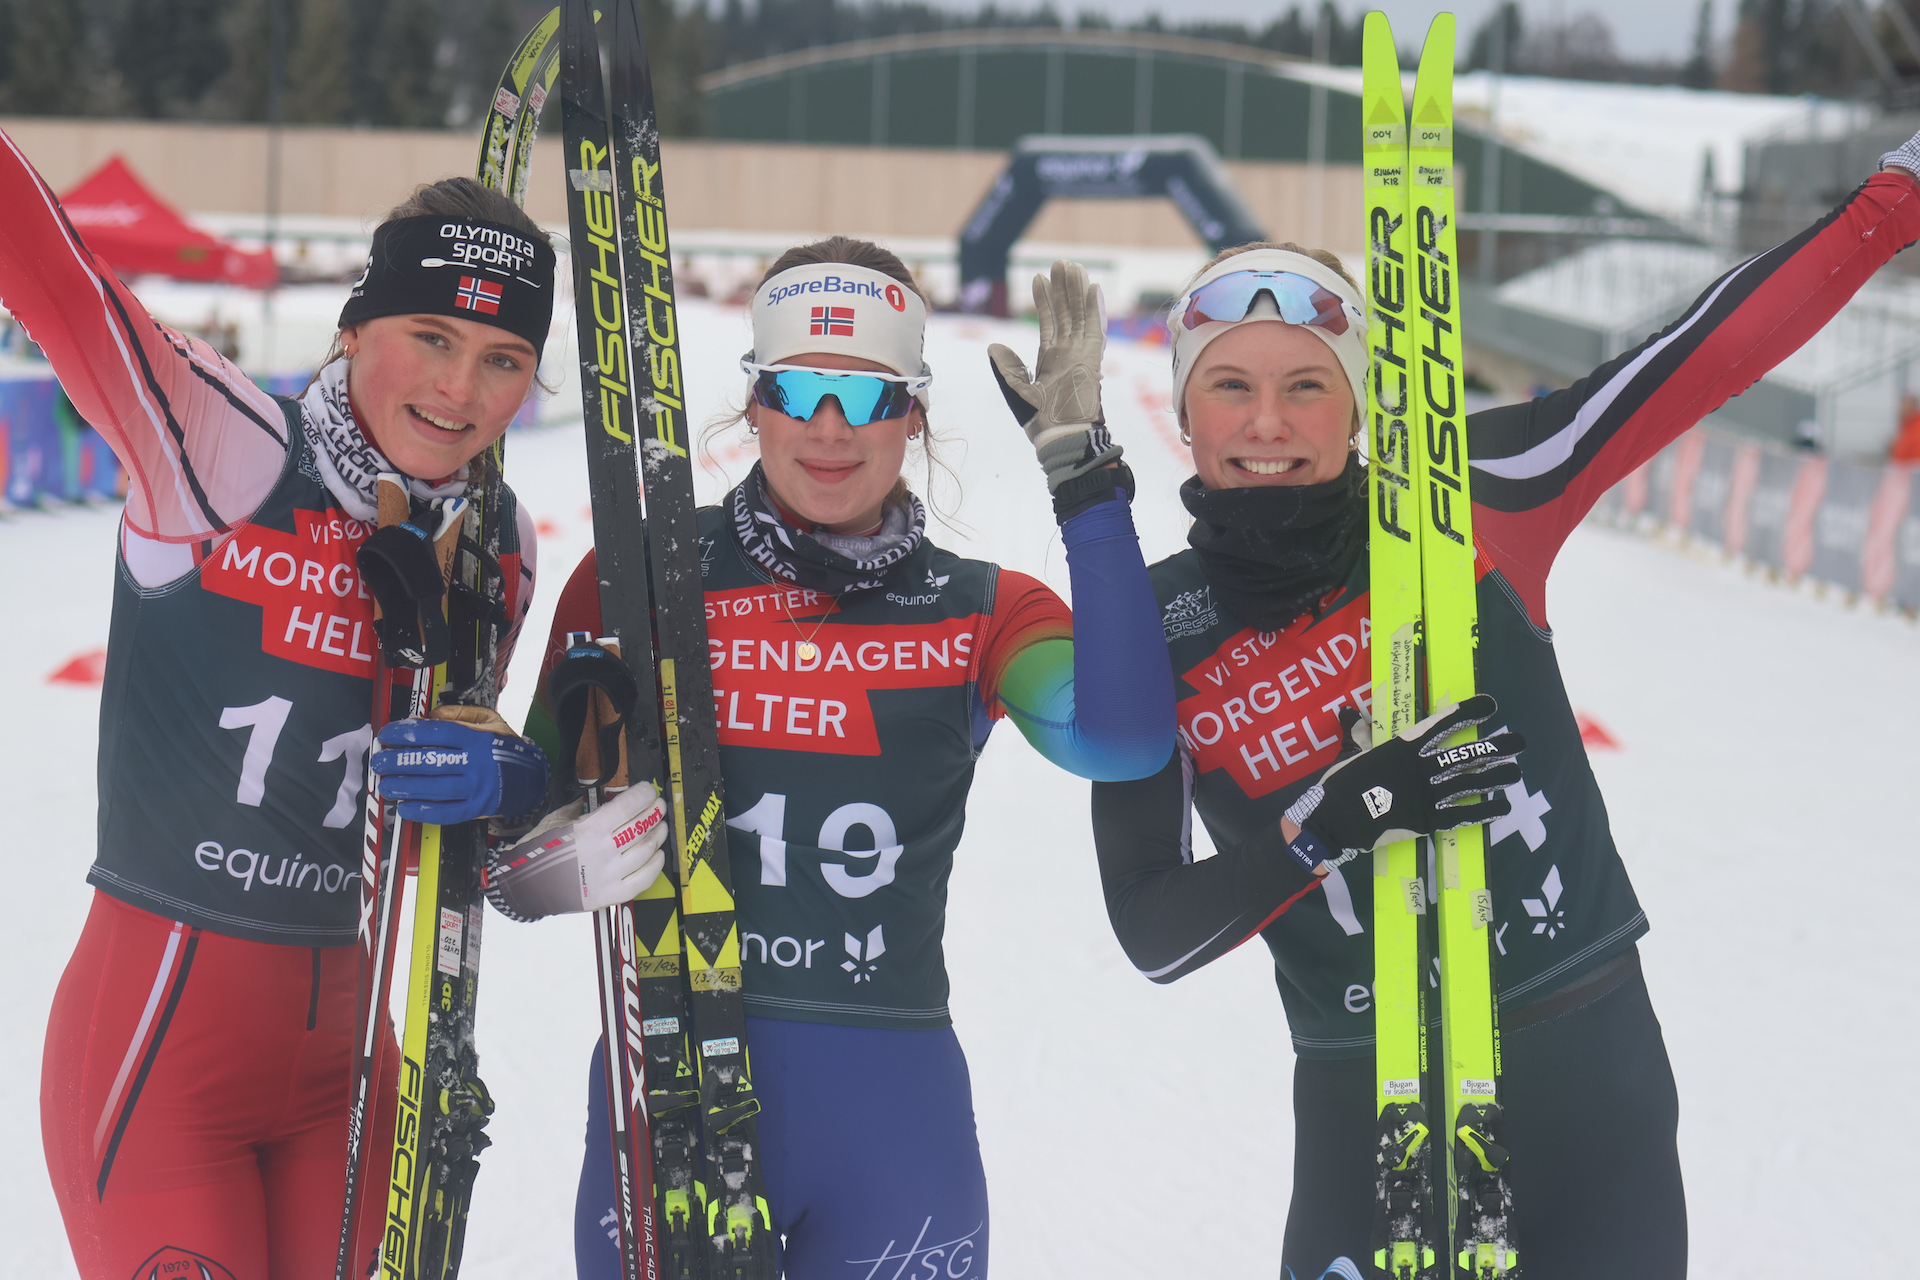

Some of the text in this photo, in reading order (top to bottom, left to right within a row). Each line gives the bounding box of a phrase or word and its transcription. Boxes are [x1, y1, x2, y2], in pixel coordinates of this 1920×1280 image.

[1372, 130, 1392, 139] 004
[1421, 132, 1441, 141] 004
[580, 140, 632, 444] FISCHER
[767, 276, 883, 307] SpareBank
[632, 156, 686, 458] FISCHER
[1371, 207, 1411, 543] FISCHER
[1416, 205, 1465, 546] FISCHER
[704, 589, 820, 620] STØTTER
[886, 592, 941, 608] equinor
[1205, 661, 1231, 687] VI
[218, 694, 374, 830] 11
[1436, 739, 1499, 768] HESTRA
[725, 792, 905, 899] 19
[1291, 843, 1314, 868] HESTRA
[1306, 843, 1314, 852] 8
[194, 839, 362, 894] equinor
[653, 1019, 678, 1028] Sirekrok
[713, 1039, 737, 1048] Sirekrok
[1389, 1080, 1413, 1090] Bjugan
[1466, 1080, 1489, 1089] Bjugan
[643, 1206, 656, 1255] TRIAC
[162, 1260, 190, 1273] 1979
